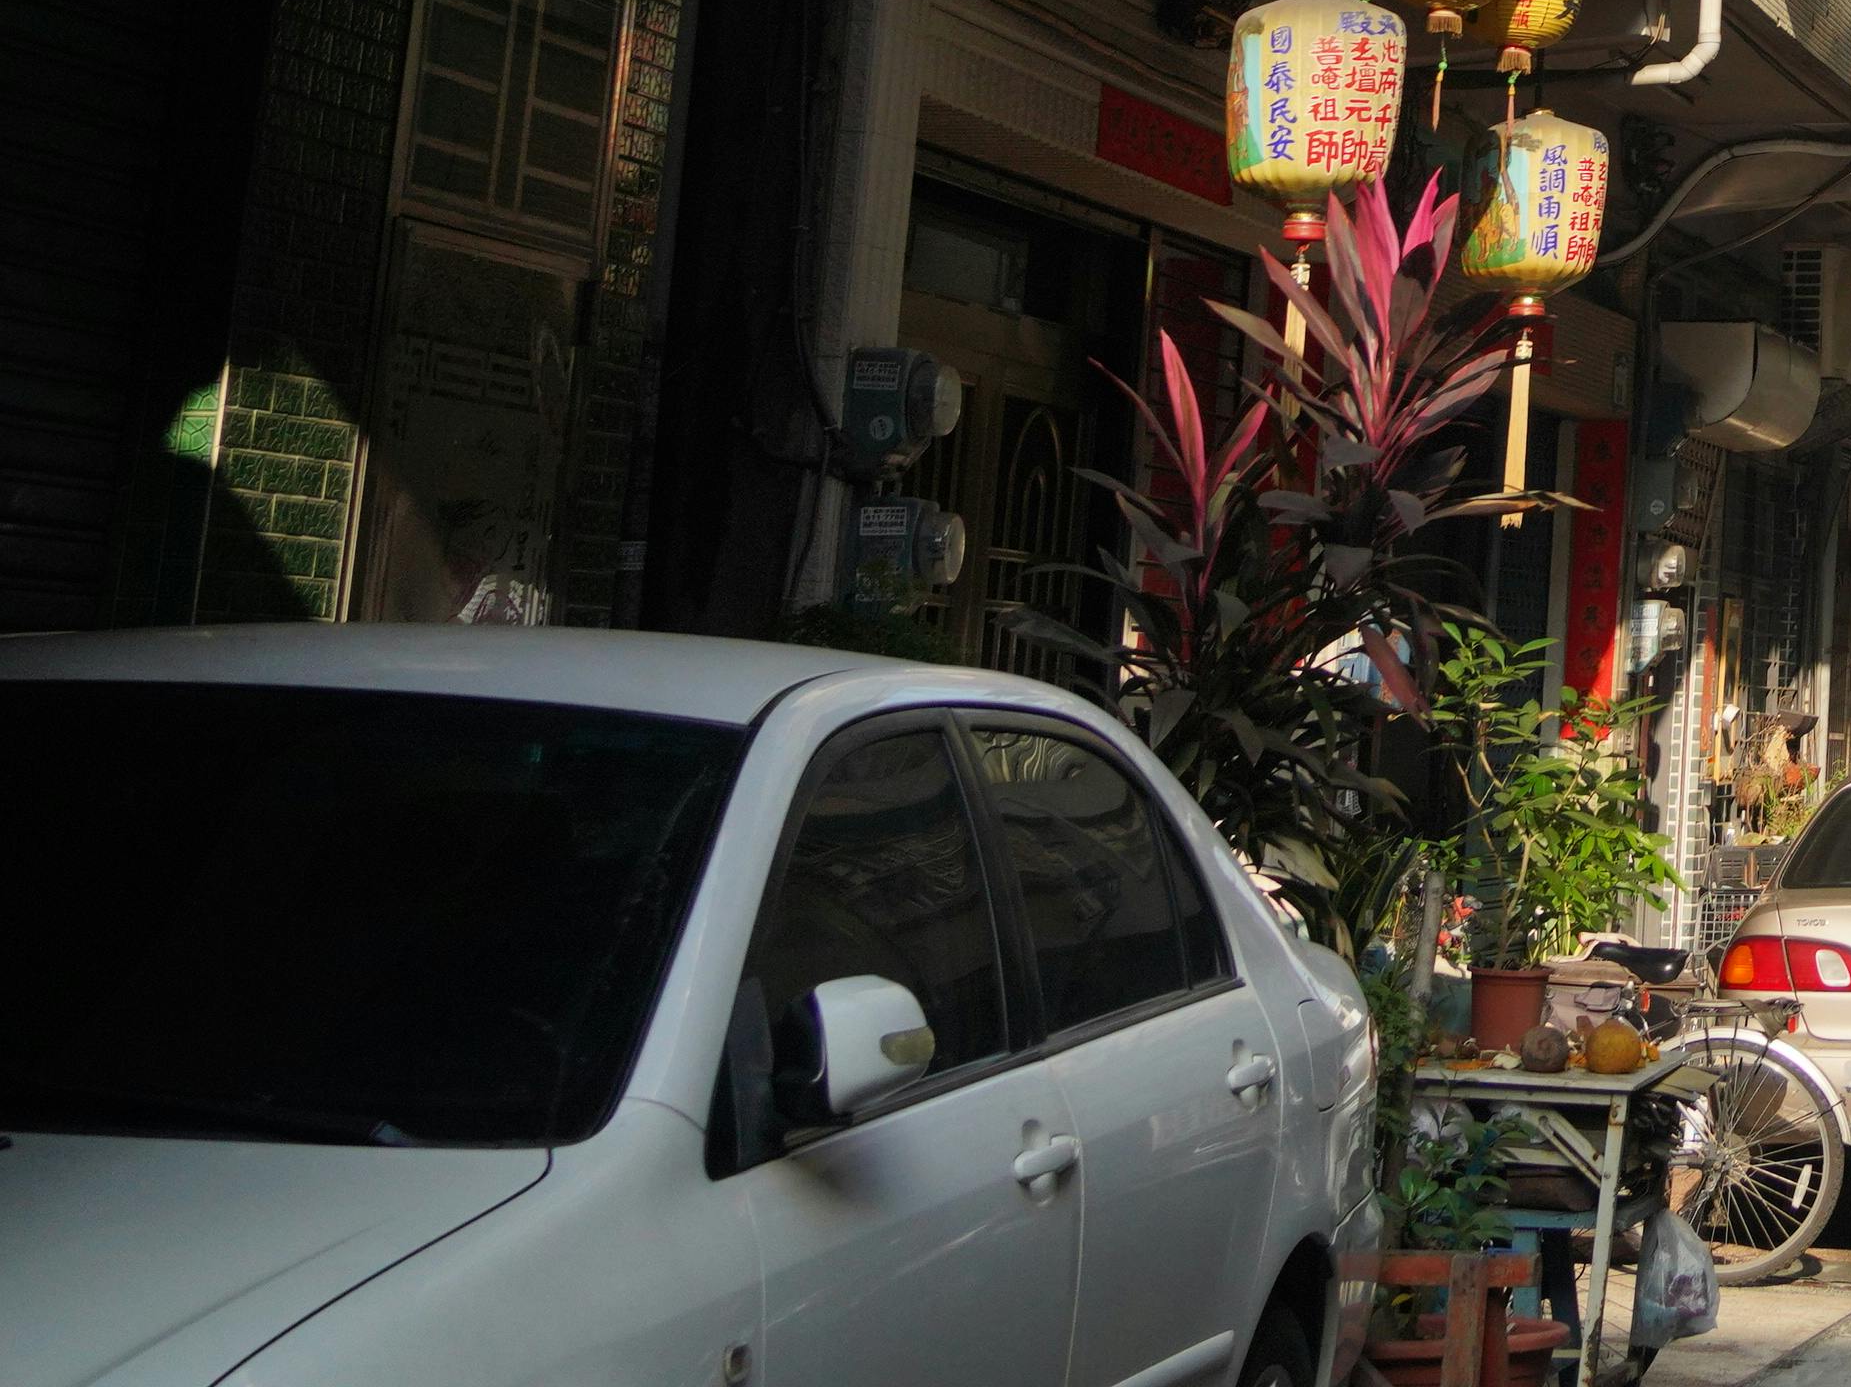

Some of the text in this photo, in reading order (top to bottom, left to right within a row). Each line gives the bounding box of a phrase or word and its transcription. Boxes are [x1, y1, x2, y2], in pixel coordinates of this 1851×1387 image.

[1264, 26, 1297, 162] 國泰民安
[1531, 143, 1569, 261] 風調雨順
